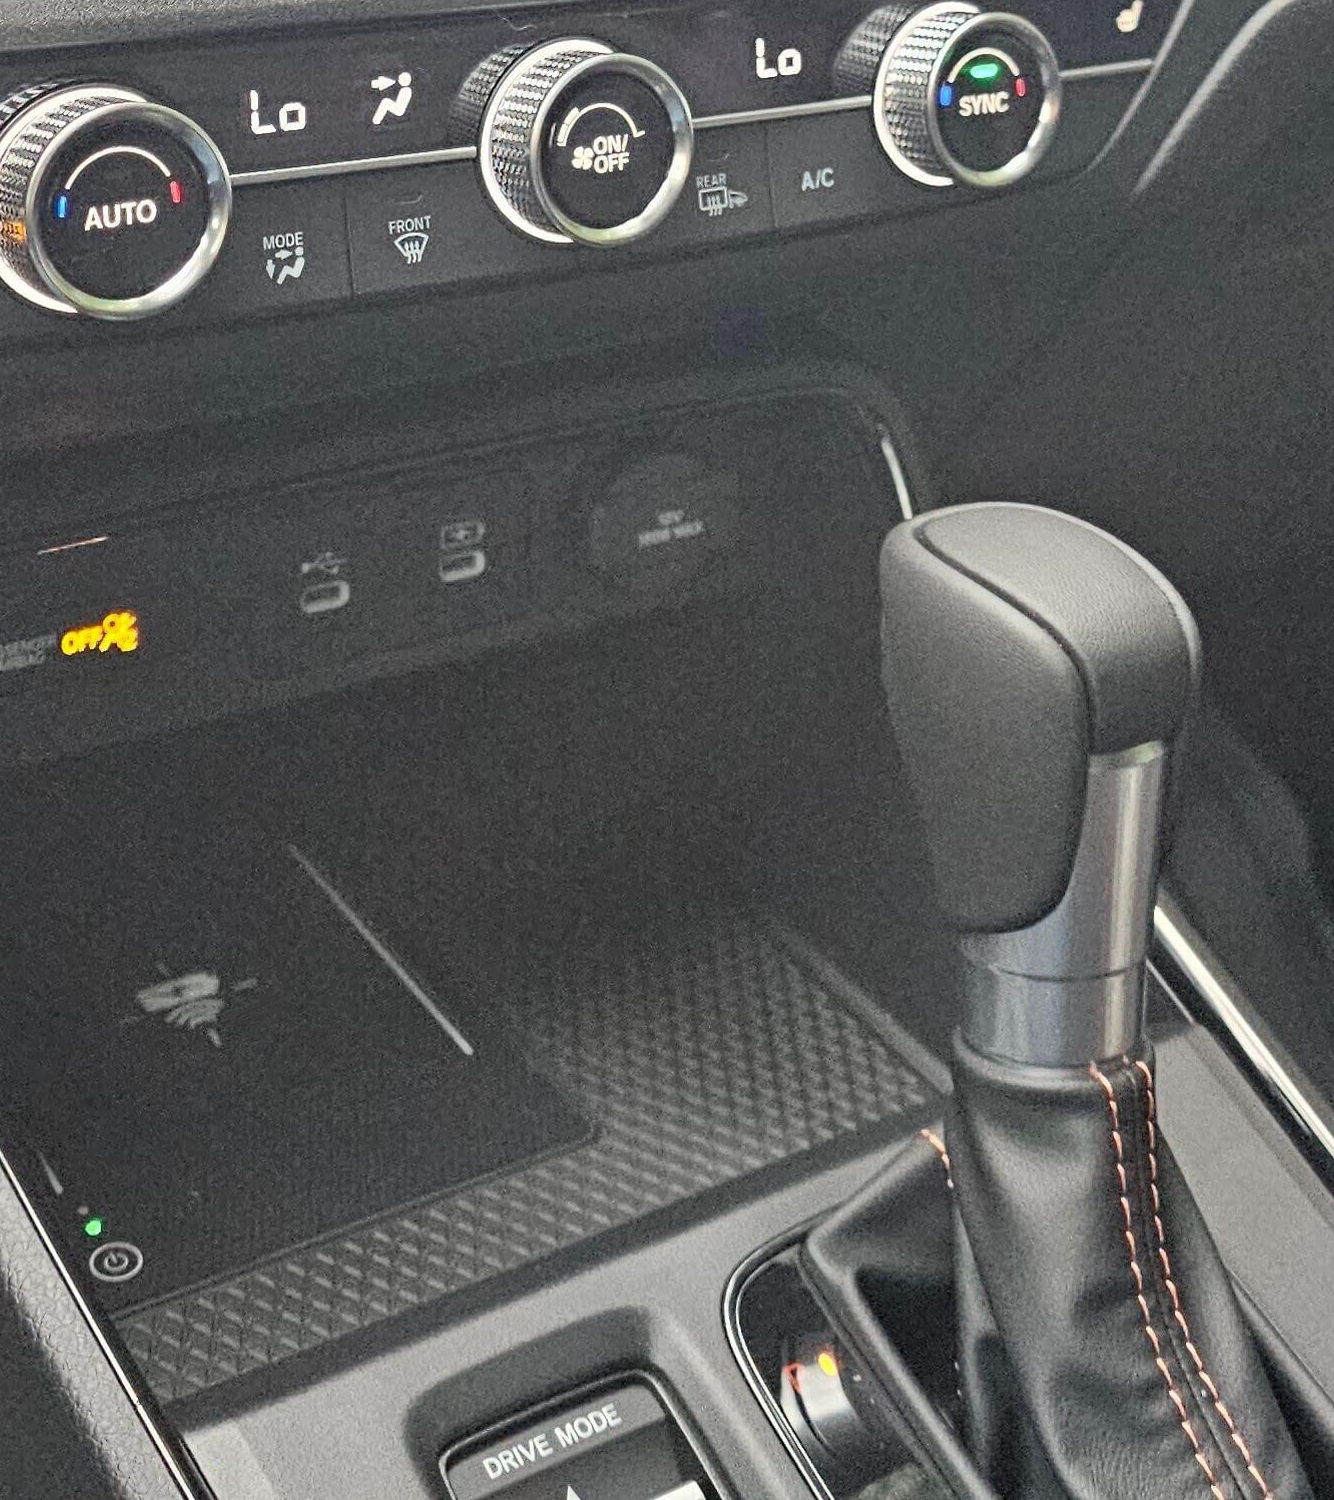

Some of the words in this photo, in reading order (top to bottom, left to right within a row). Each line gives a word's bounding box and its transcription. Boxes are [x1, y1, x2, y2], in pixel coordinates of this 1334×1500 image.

[755, 39, 802, 79] Lo
[250, 90, 307, 135] Lo
[958, 92, 1009, 118] SYNC
[593, 134, 629, 155] ON/
[593, 151, 630, 175] OFF
[696, 173, 728, 189] REAR
[801, 168, 835, 191] A/C
[84, 199, 157, 232] AUTO
[388, 215, 431, 235] FRONT
[263, 232, 304, 251] MODE
[482, 1431, 555, 1481] DRIVE
[553, 1402, 623, 1447] MODE
